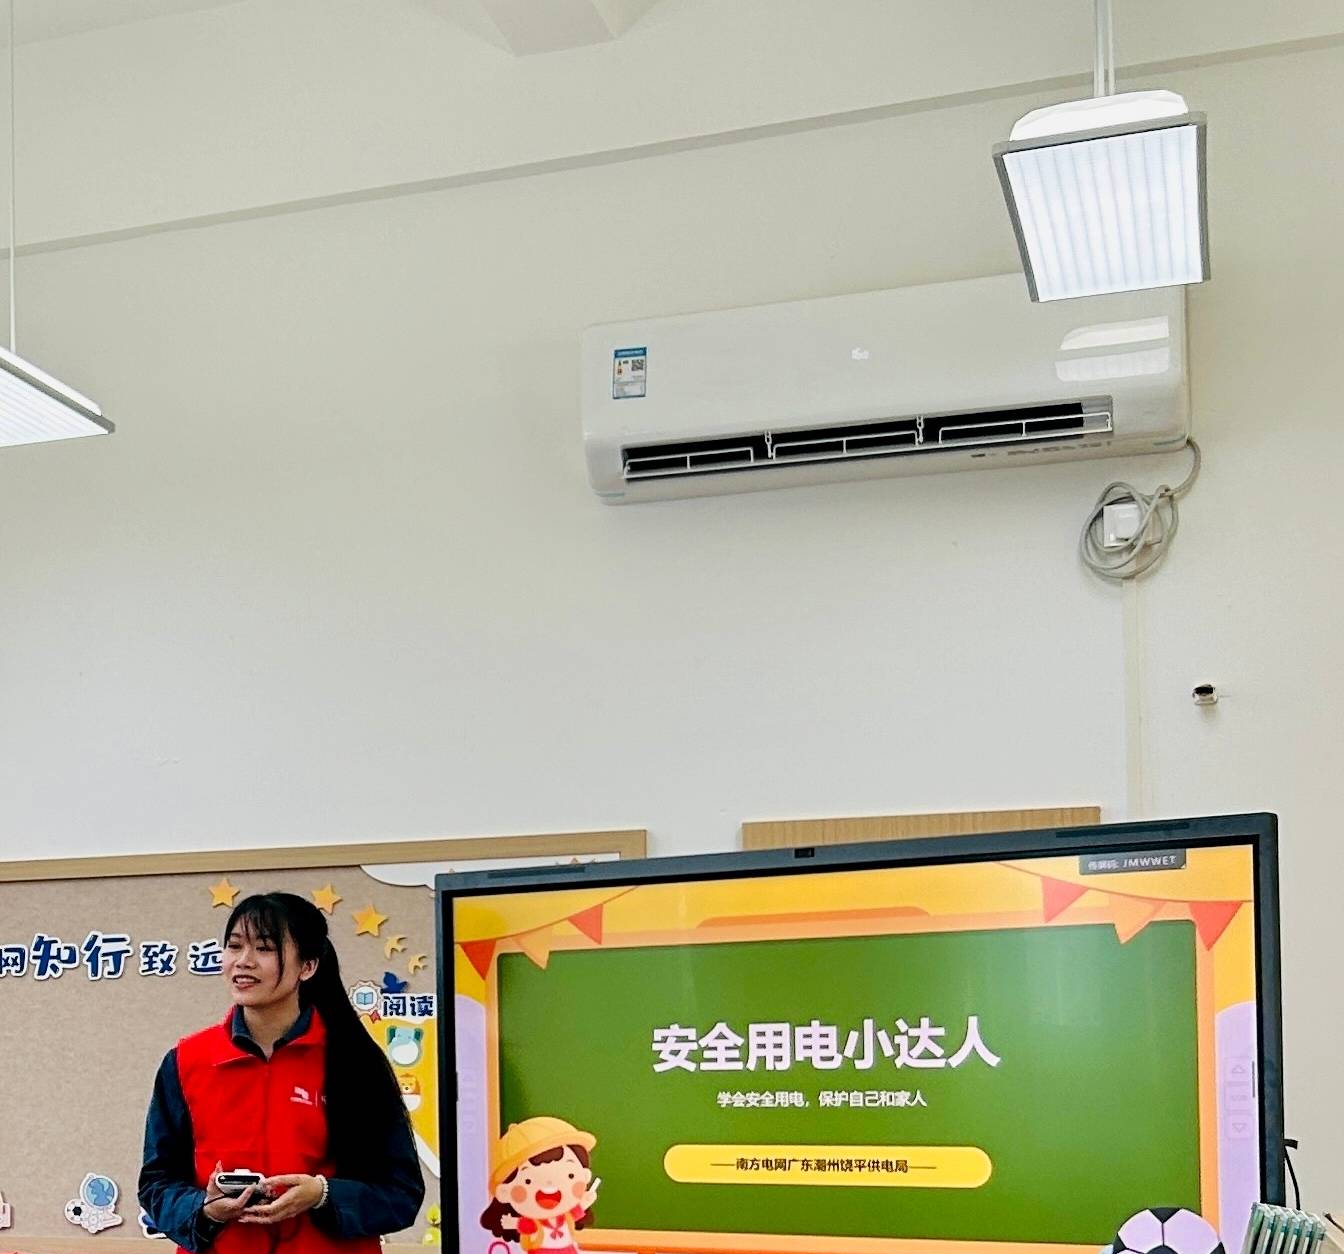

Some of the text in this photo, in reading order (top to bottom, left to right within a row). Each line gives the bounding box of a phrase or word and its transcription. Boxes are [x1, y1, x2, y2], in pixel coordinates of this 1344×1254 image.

[383, 995, 433, 1016] 阅读
[652, 1015, 1001, 1073] 安全用电小达人
